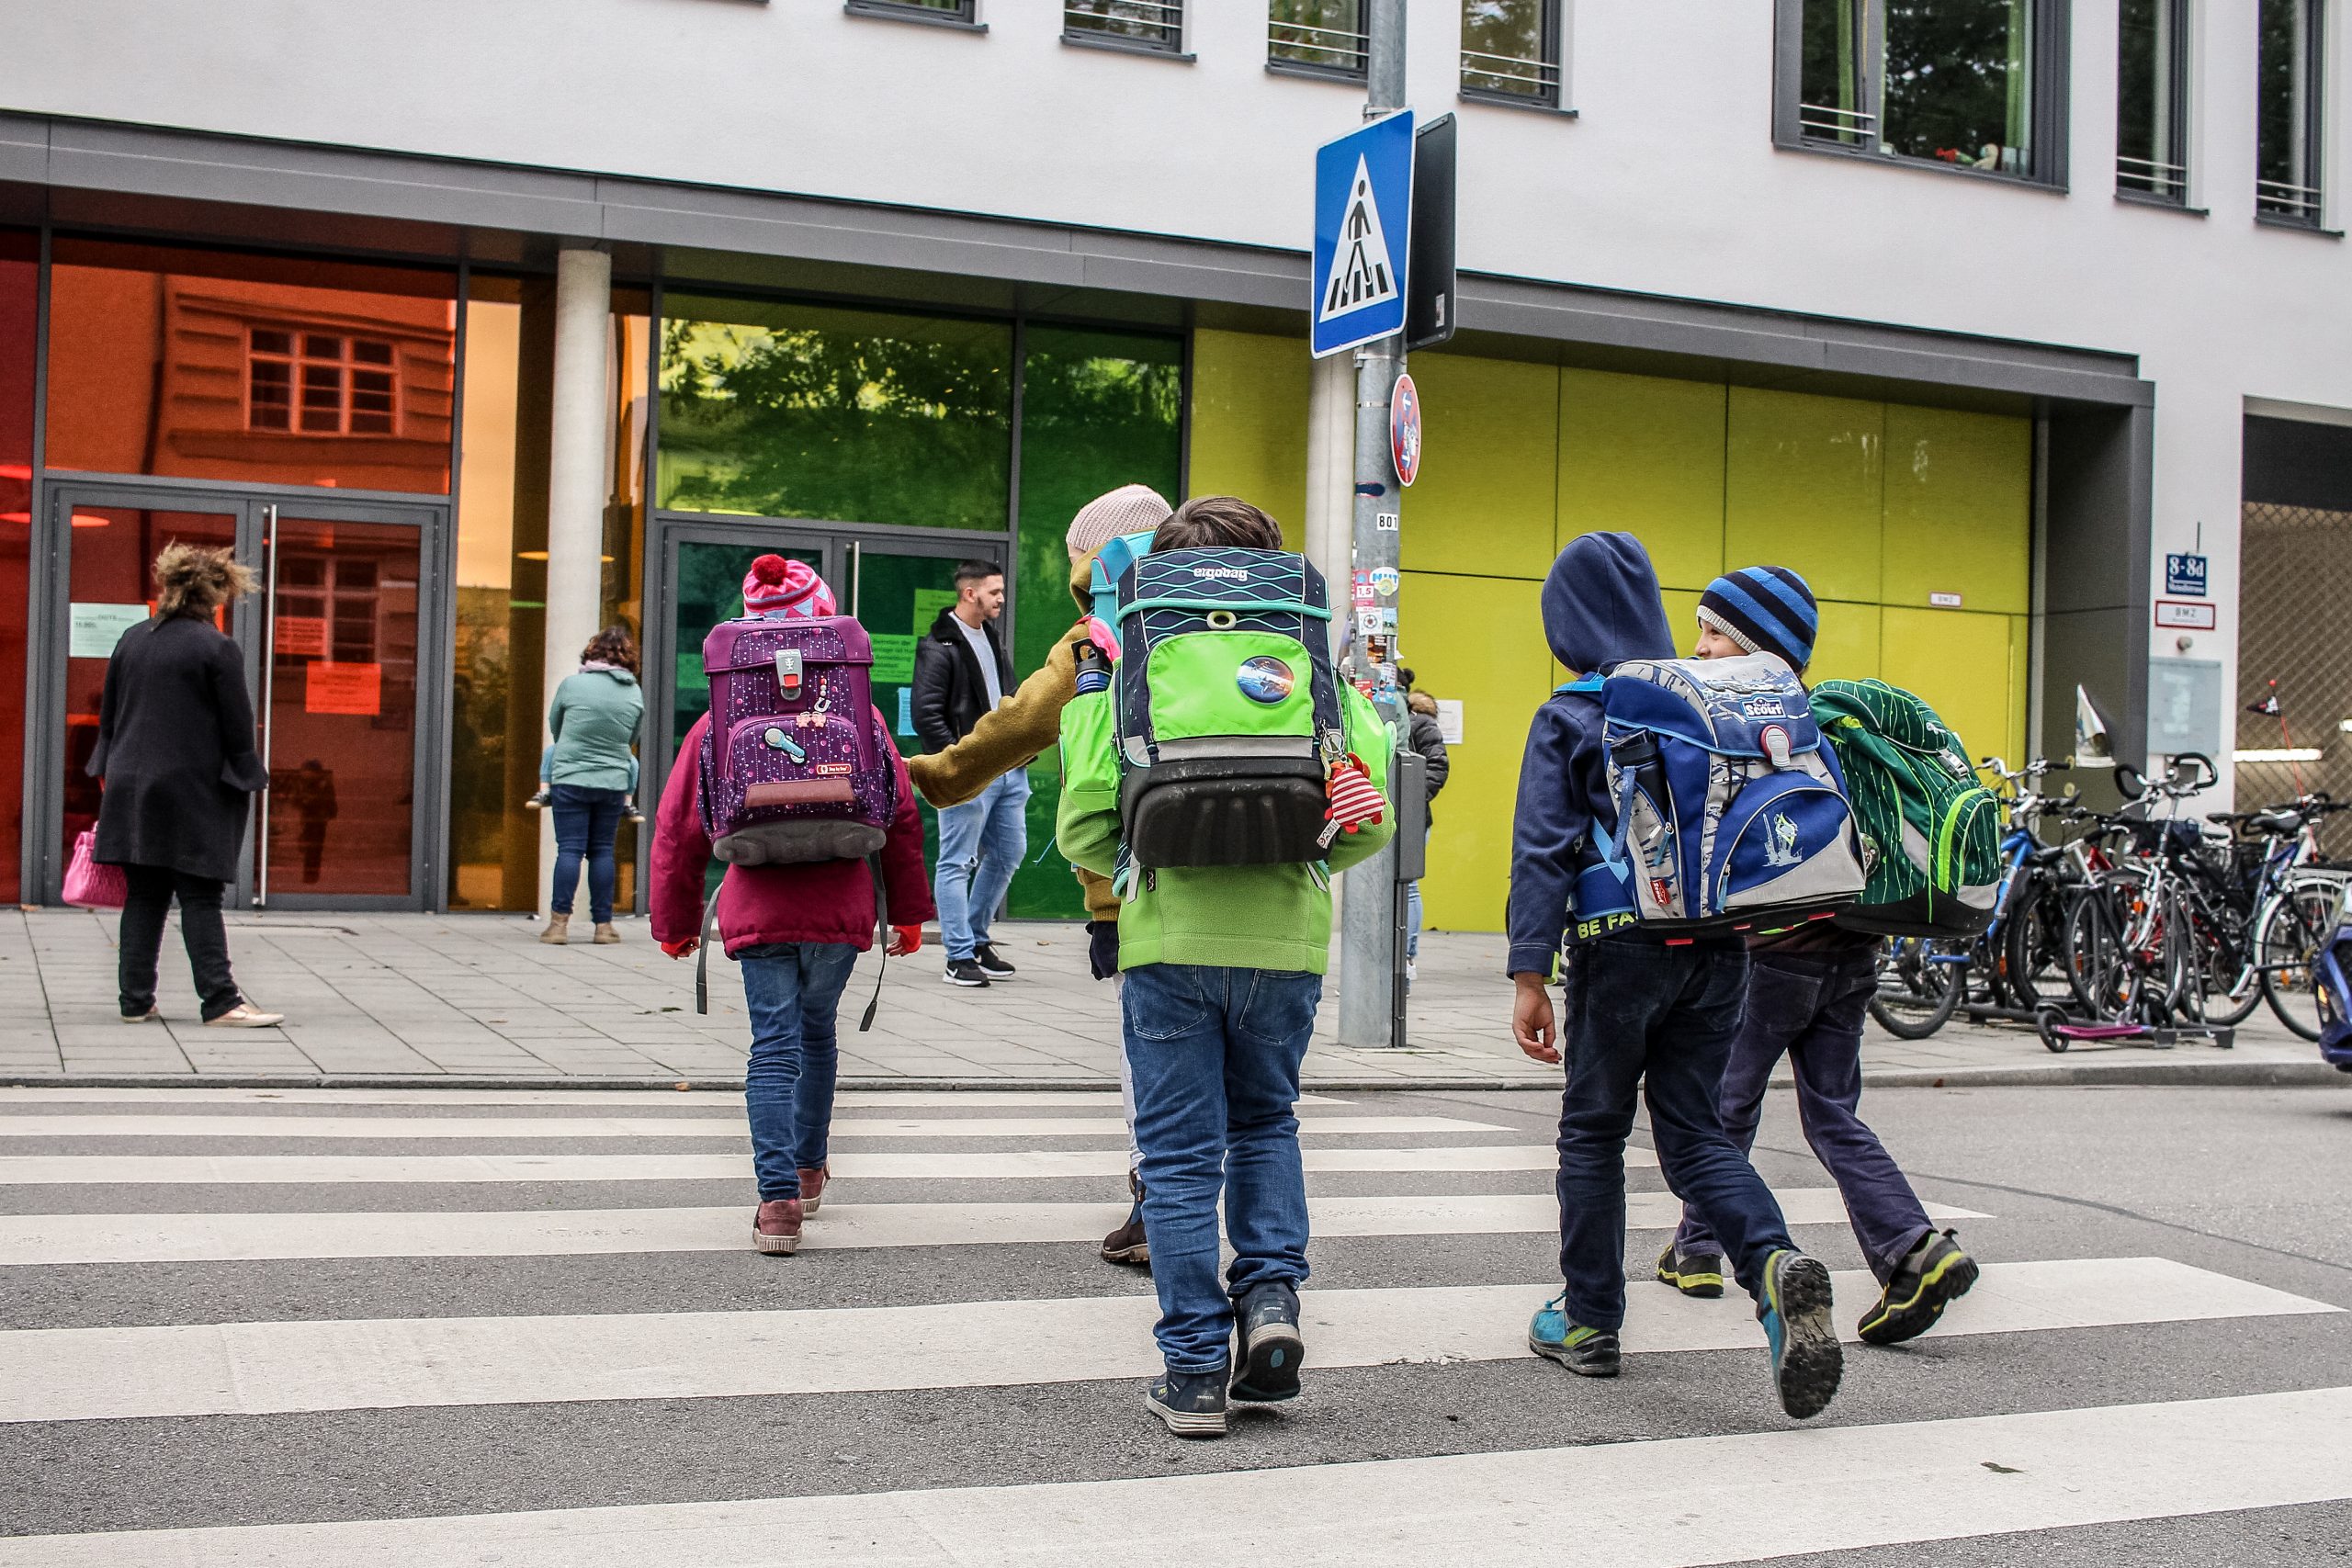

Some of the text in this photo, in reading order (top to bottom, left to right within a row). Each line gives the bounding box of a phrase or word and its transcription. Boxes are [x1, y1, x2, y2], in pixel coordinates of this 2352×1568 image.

[1379, 515, 1397, 529] 801
[1193, 567, 1249, 582] ergobag
[1745, 704, 1782, 716] Scout
[1577, 919, 1601, 939] BE
